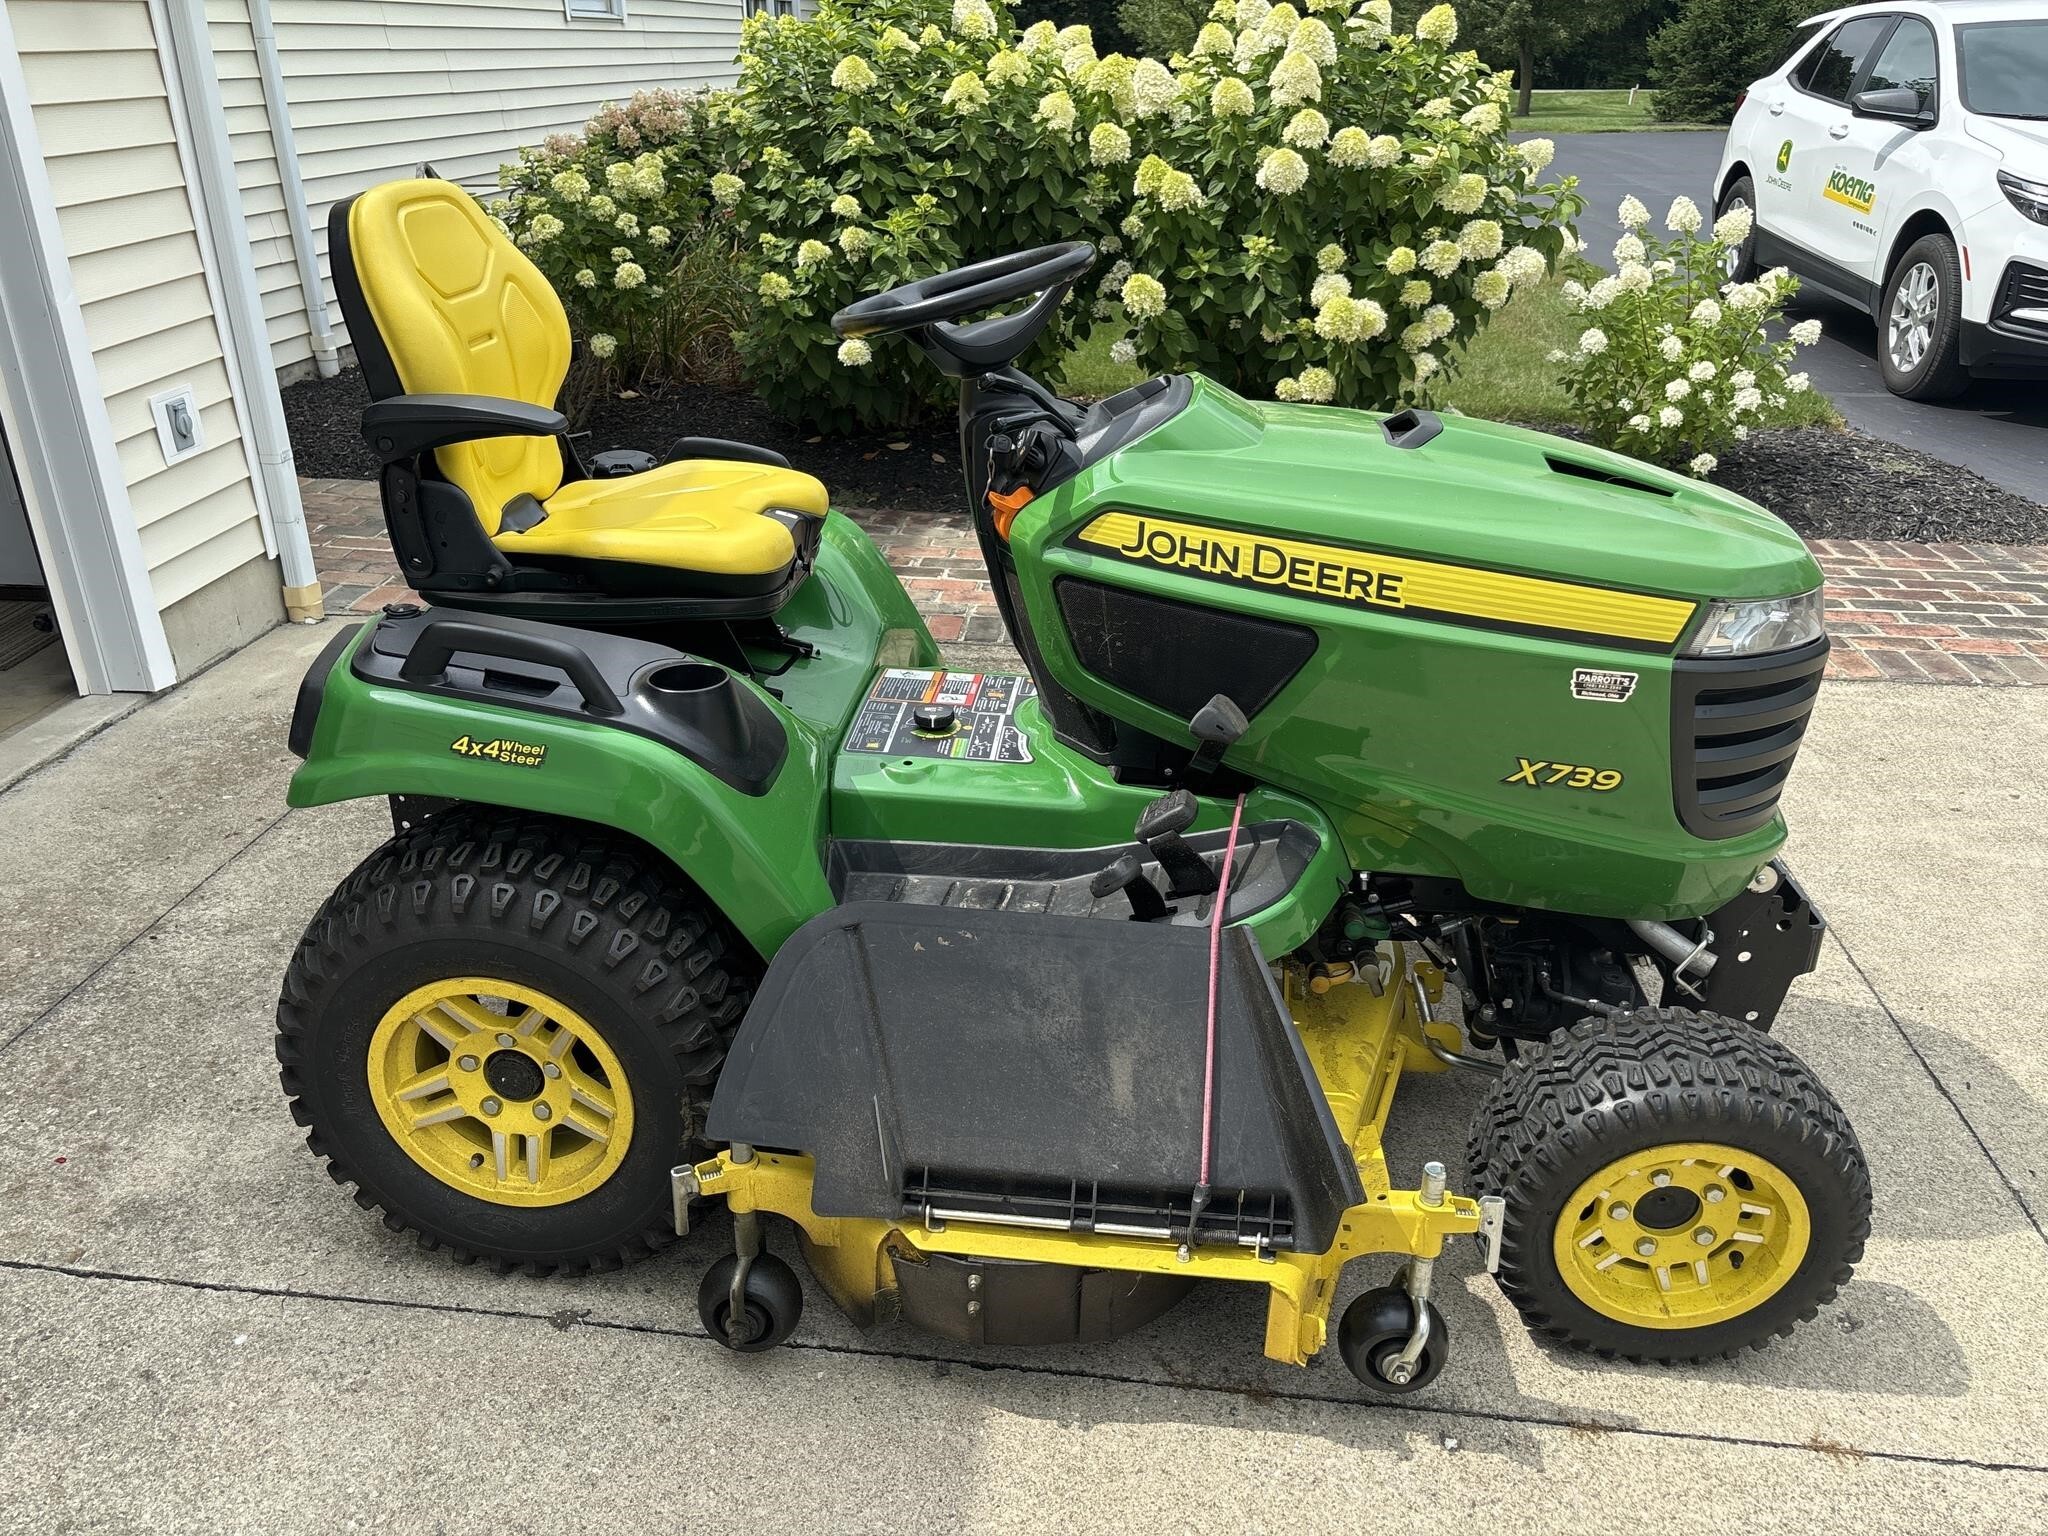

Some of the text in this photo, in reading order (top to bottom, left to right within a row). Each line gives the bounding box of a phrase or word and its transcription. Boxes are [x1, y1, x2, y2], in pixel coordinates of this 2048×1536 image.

[1121, 520, 1405, 606] JOHN DEERE
[1578, 674, 1631, 686] PARROTT'S
[452, 736, 545, 758] 4x4 Wheel
[499, 751, 542, 766] Steer
[1503, 757, 1624, 792] X739
